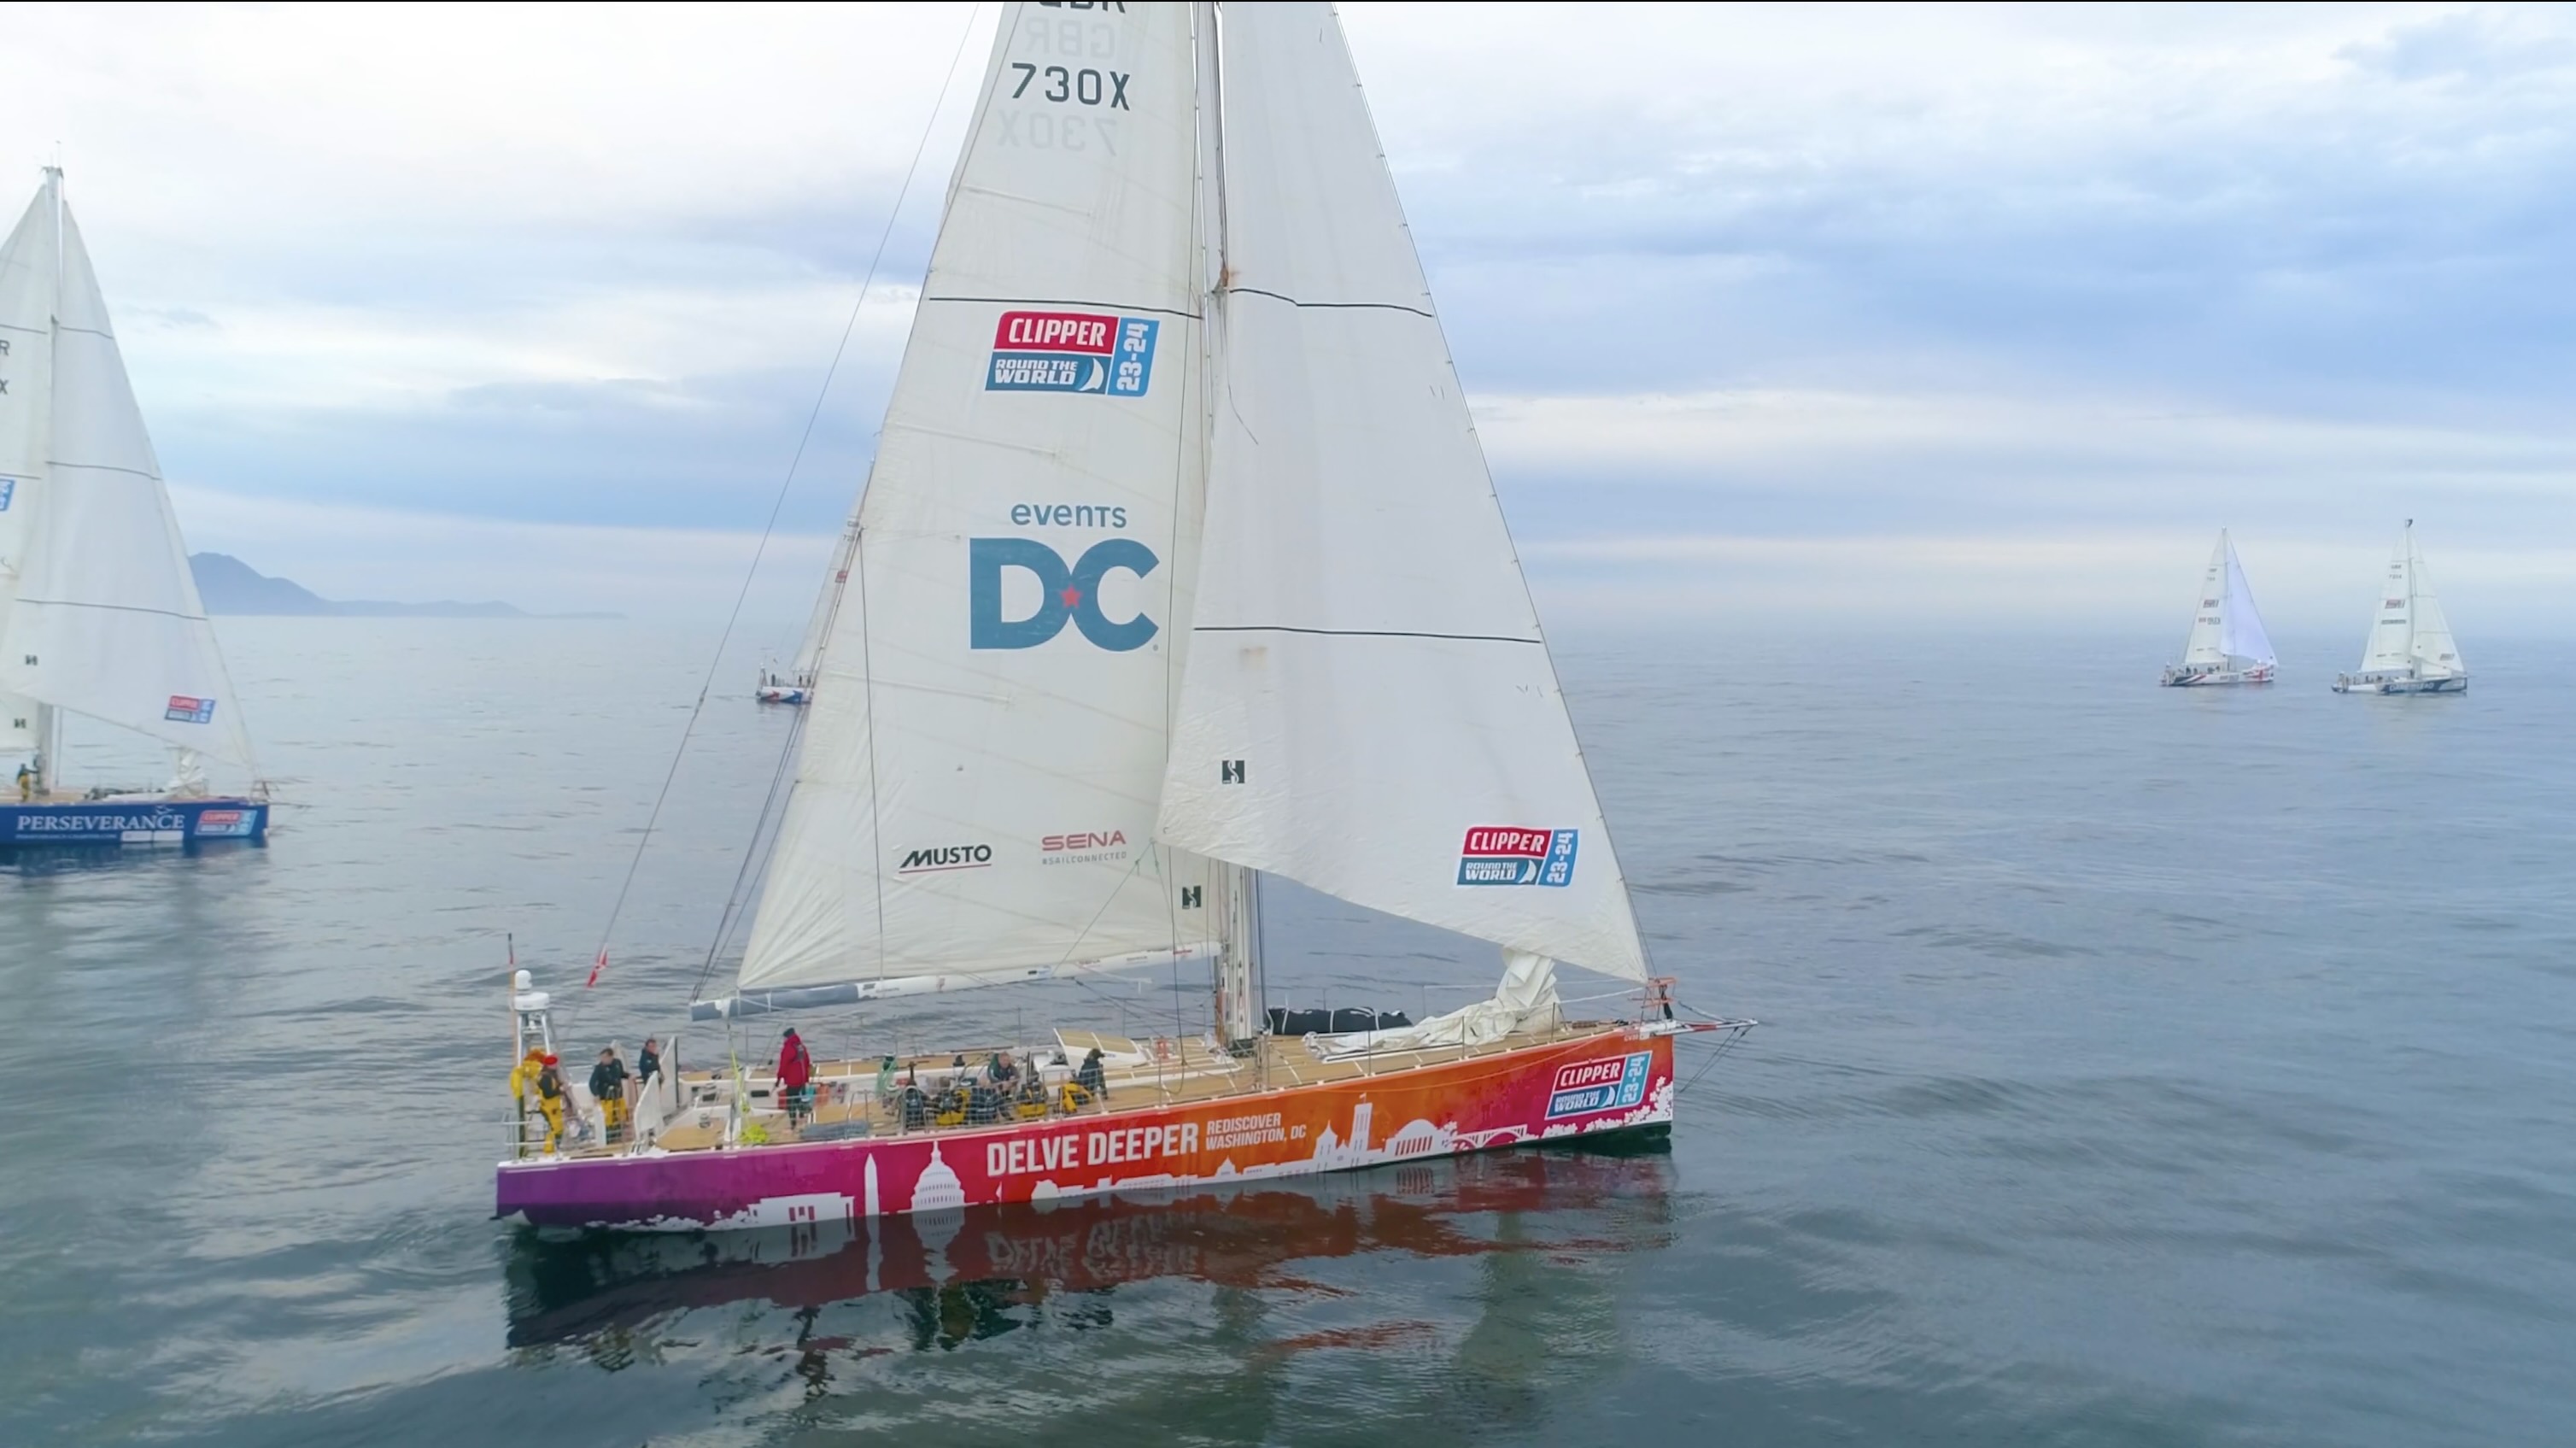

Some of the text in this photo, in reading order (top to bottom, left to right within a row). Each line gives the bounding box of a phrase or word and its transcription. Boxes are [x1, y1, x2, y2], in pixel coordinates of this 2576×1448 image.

[1011, 62, 1130, 111] 730X
[1008, 318, 1107, 347] CLIPPER
[995, 359, 1079, 372] ROUND THE
[1115, 322, 1150, 392] 23-24
[994, 369, 1076, 385] WORLD
[969, 537, 1160, 652] DC
[16, 814, 185, 830] PERSEVERANCE
[1041, 830, 1127, 851] SENA
[1470, 831, 1545, 853] CLIPPER
[900, 844, 992, 868] MUSTO
[1547, 832, 1573, 883] 23-24
[1466, 870, 1517, 881] WORLD
[1560, 1062, 1621, 1087] CLIPPER
[1623, 1056, 1646, 1104] 23-24
[1554, 1096, 1600, 1112] WORLD
[1206, 1112, 1282, 1134] REDISCOVER
[1205, 1123, 1307, 1151] WASHINGTON, DC
[986, 1123, 1199, 1177] DELVE DEEPER
